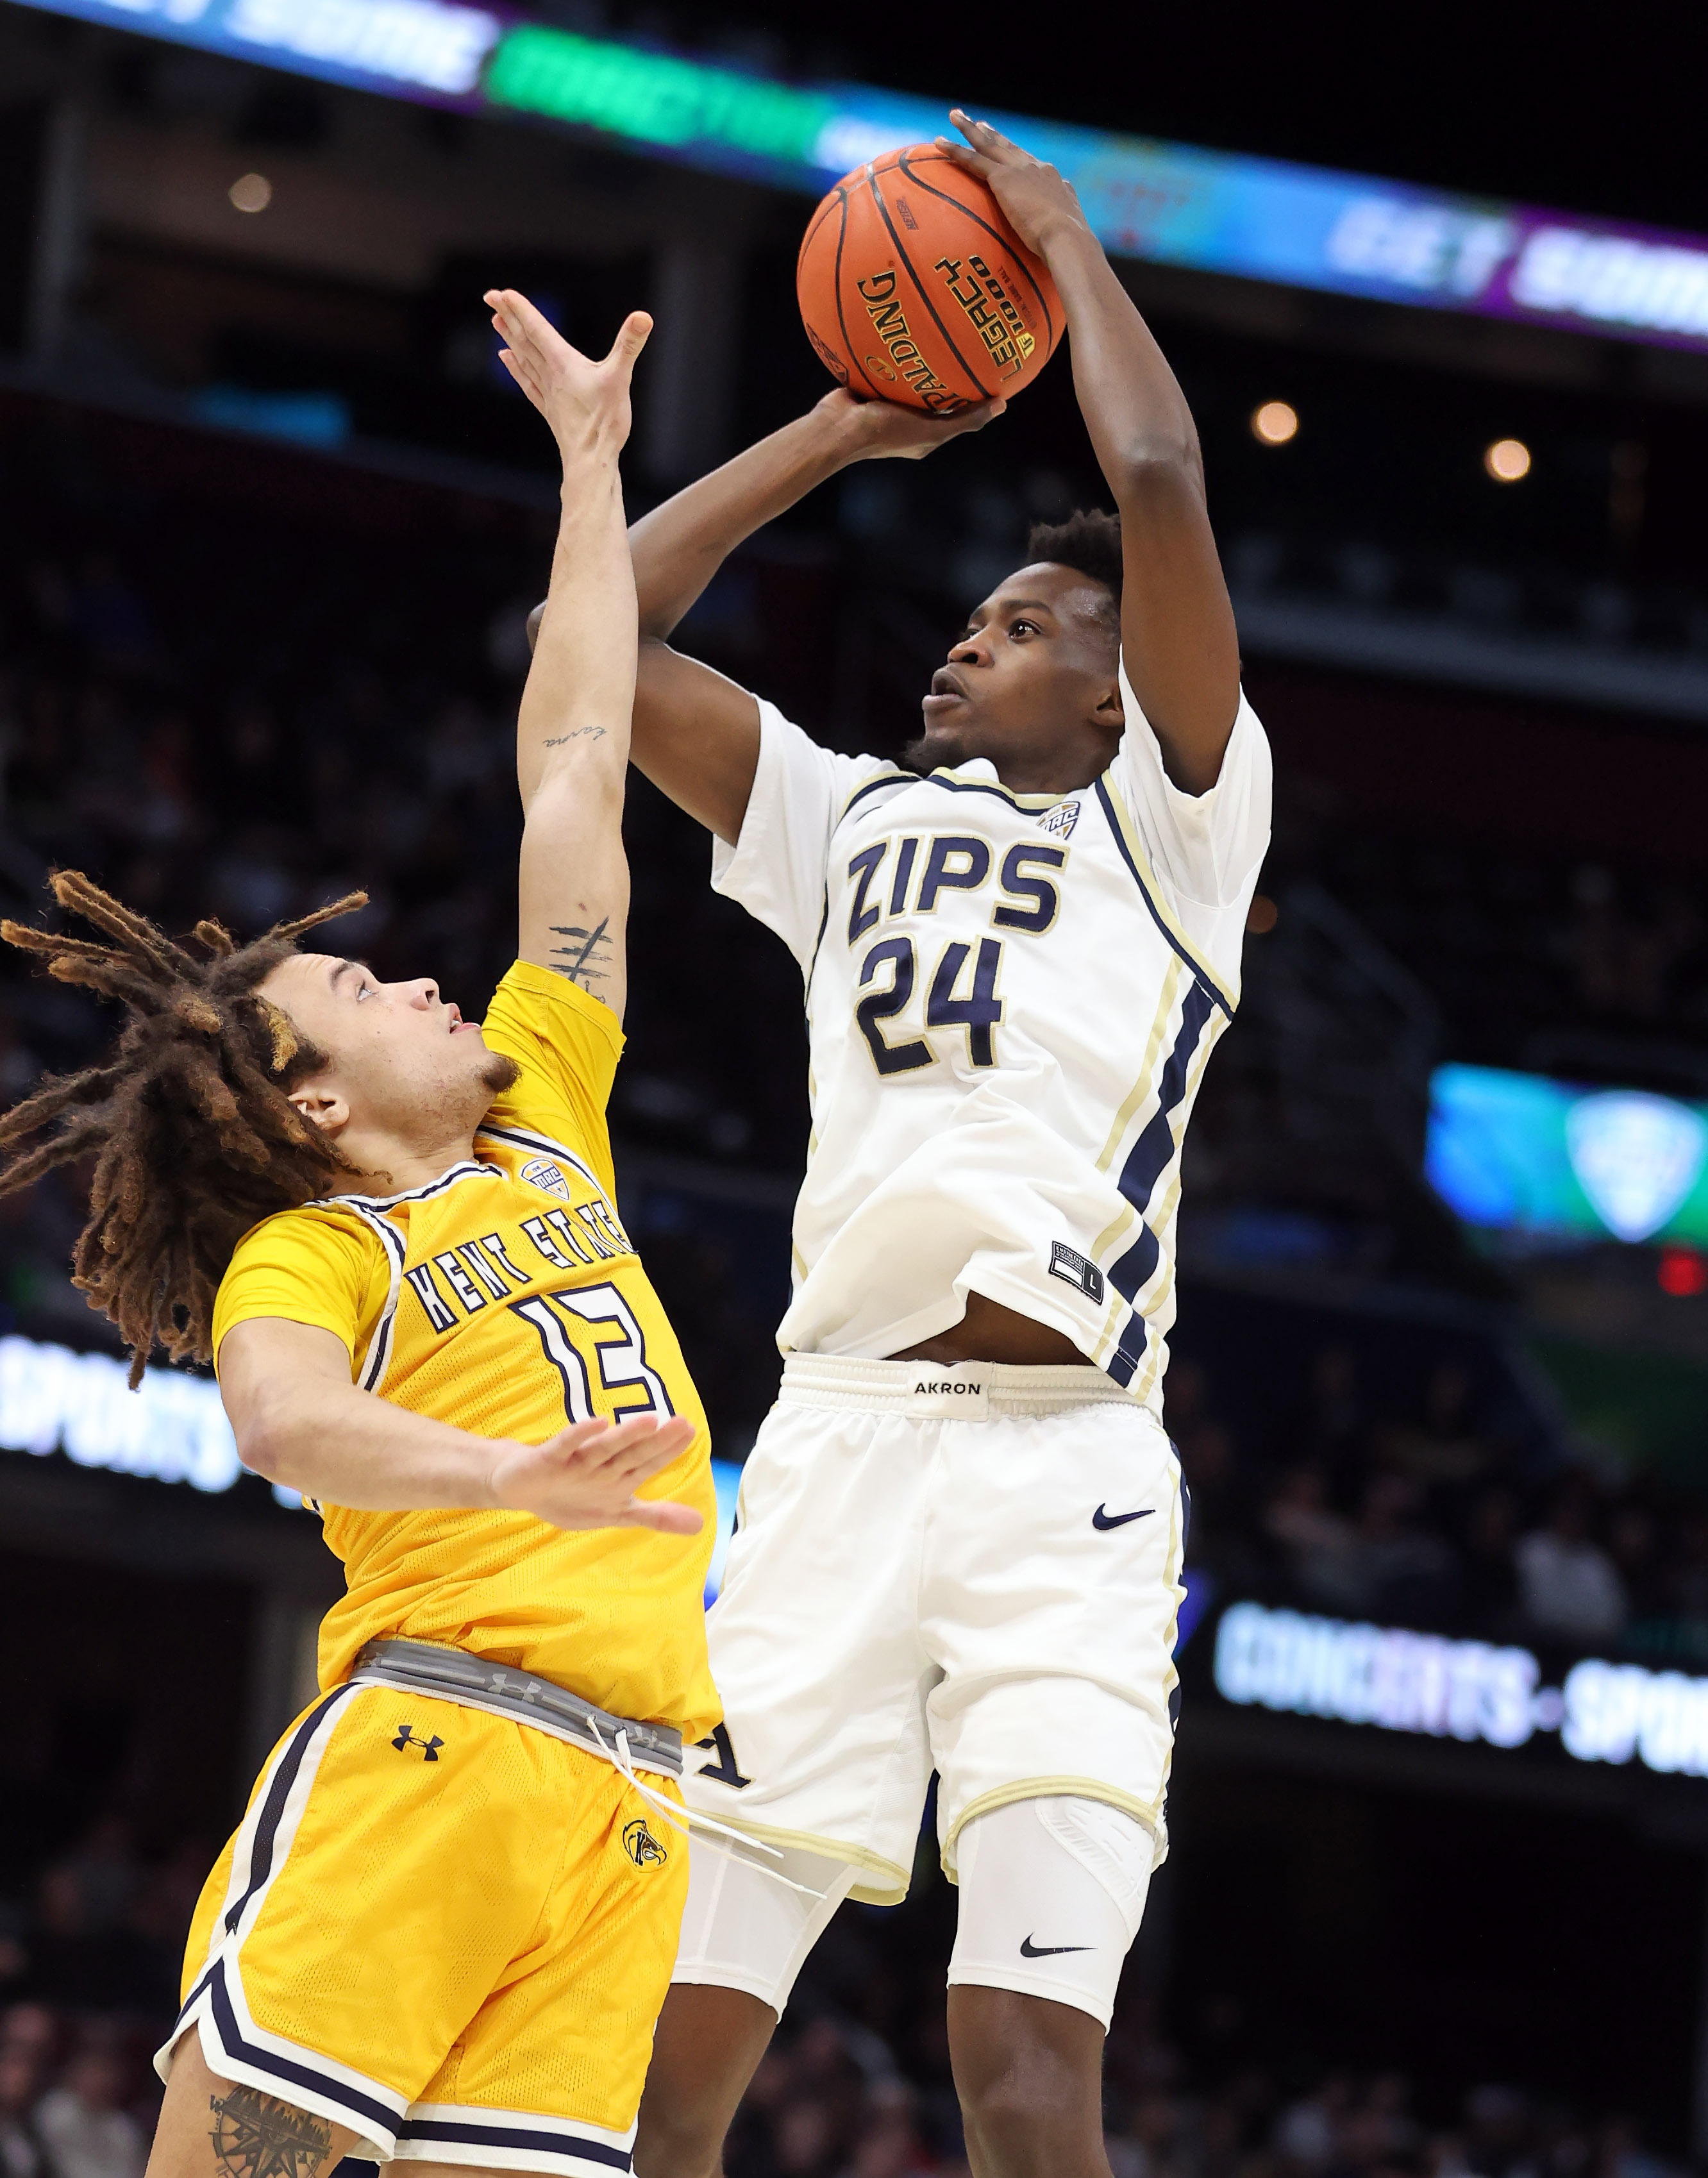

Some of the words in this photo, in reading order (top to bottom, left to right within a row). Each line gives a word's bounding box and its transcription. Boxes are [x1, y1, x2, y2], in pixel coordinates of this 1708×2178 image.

[934, 256, 1024, 383] LEGACY
[968, 255, 1026, 336] 1000
[848, 834, 1071, 951] ZIPS
[853, 932, 1007, 1078] 24
[528, 1166, 565, 1189] MAC
[404, 1232, 533, 1334] KENT
[507, 1280, 677, 1430] 13
[914, 1382, 982, 1395] AKRON
